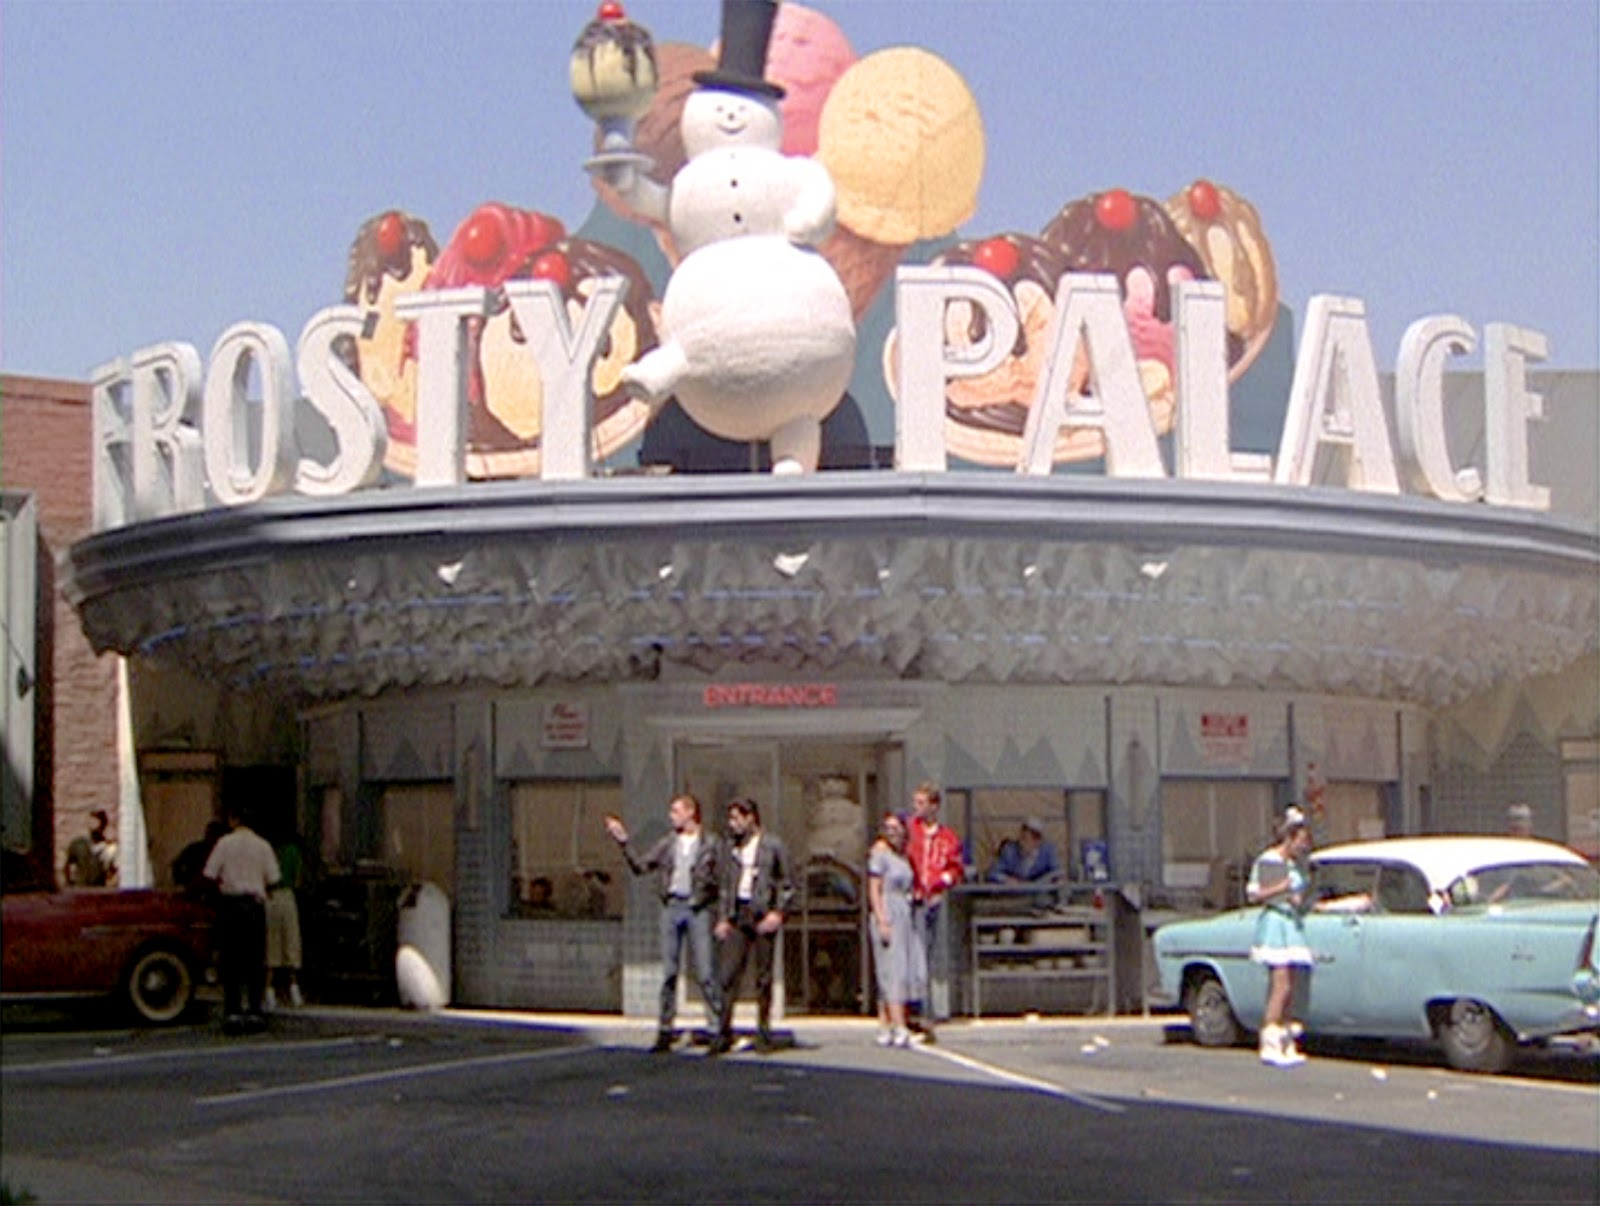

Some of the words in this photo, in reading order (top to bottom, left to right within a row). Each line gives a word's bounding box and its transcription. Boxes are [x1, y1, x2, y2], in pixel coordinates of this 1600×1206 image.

[92, 274, 628, 531] FROSTY
[895, 264, 1550, 509] PALACE
[704, 683, 838, 707] ENTRANCE
